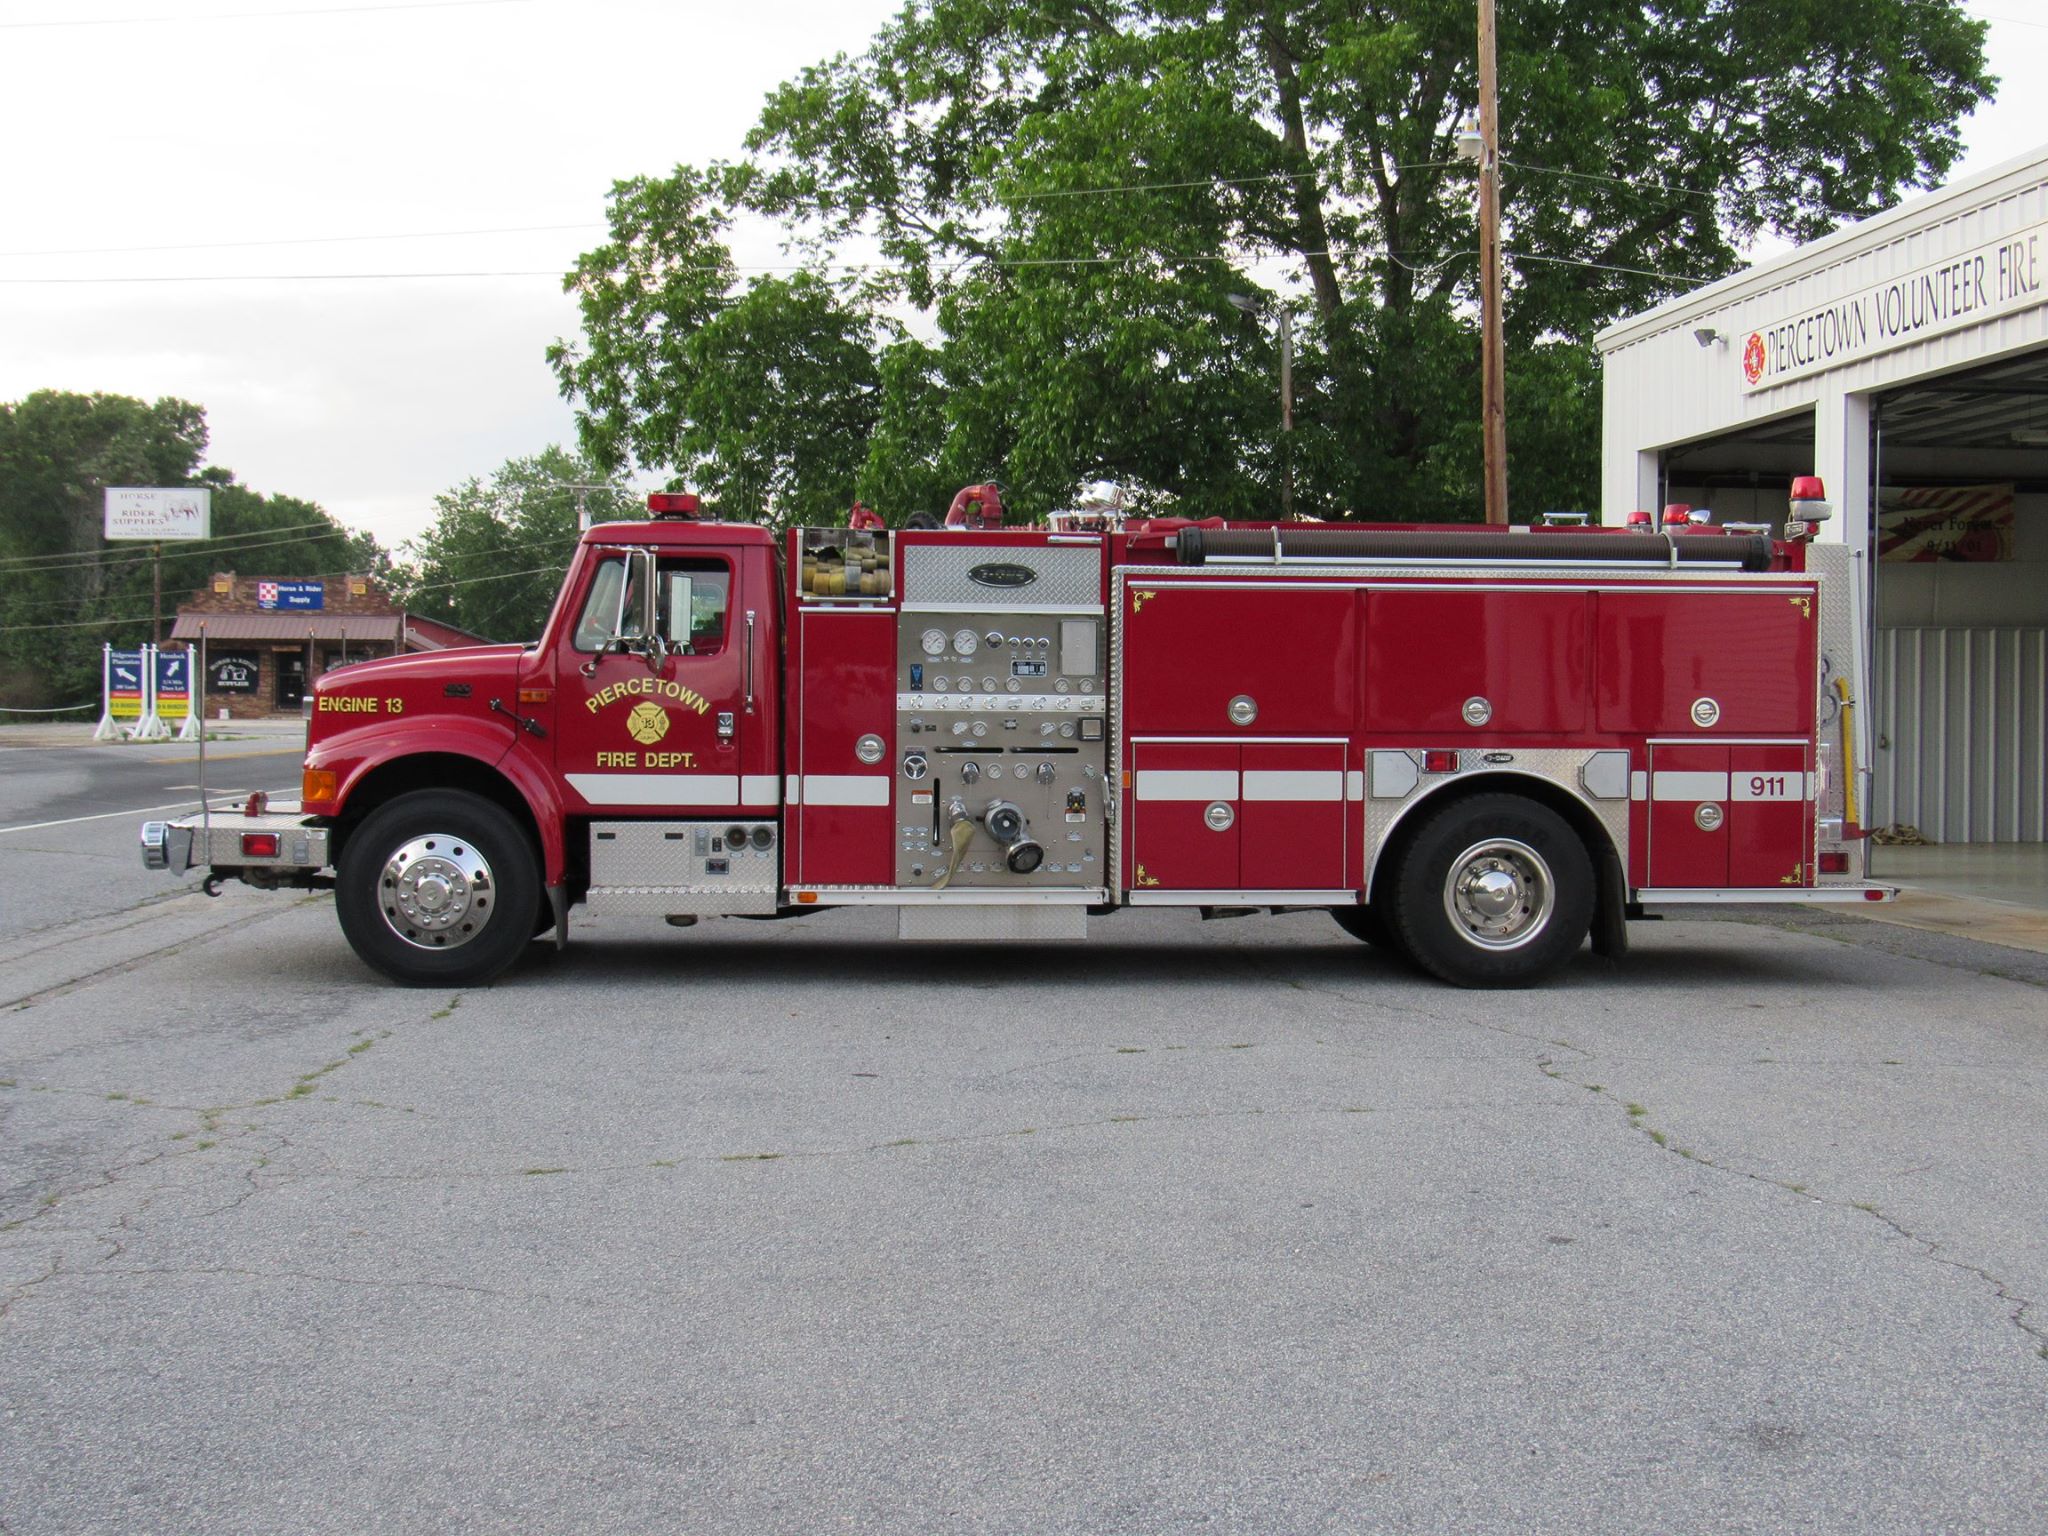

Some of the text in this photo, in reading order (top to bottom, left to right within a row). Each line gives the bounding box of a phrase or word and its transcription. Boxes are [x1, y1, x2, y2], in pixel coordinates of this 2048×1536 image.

[1768, 234, 2040, 376] PIERCETOWN VOLUNTEER FIRE
[318, 697, 403, 713] ENGINE 13
[585, 678, 711, 716] PIERCETOWN
[640, 717, 656, 729] 13
[597, 752, 698, 769] FIRE DEPT.
[1750, 776, 1785, 797] 911
